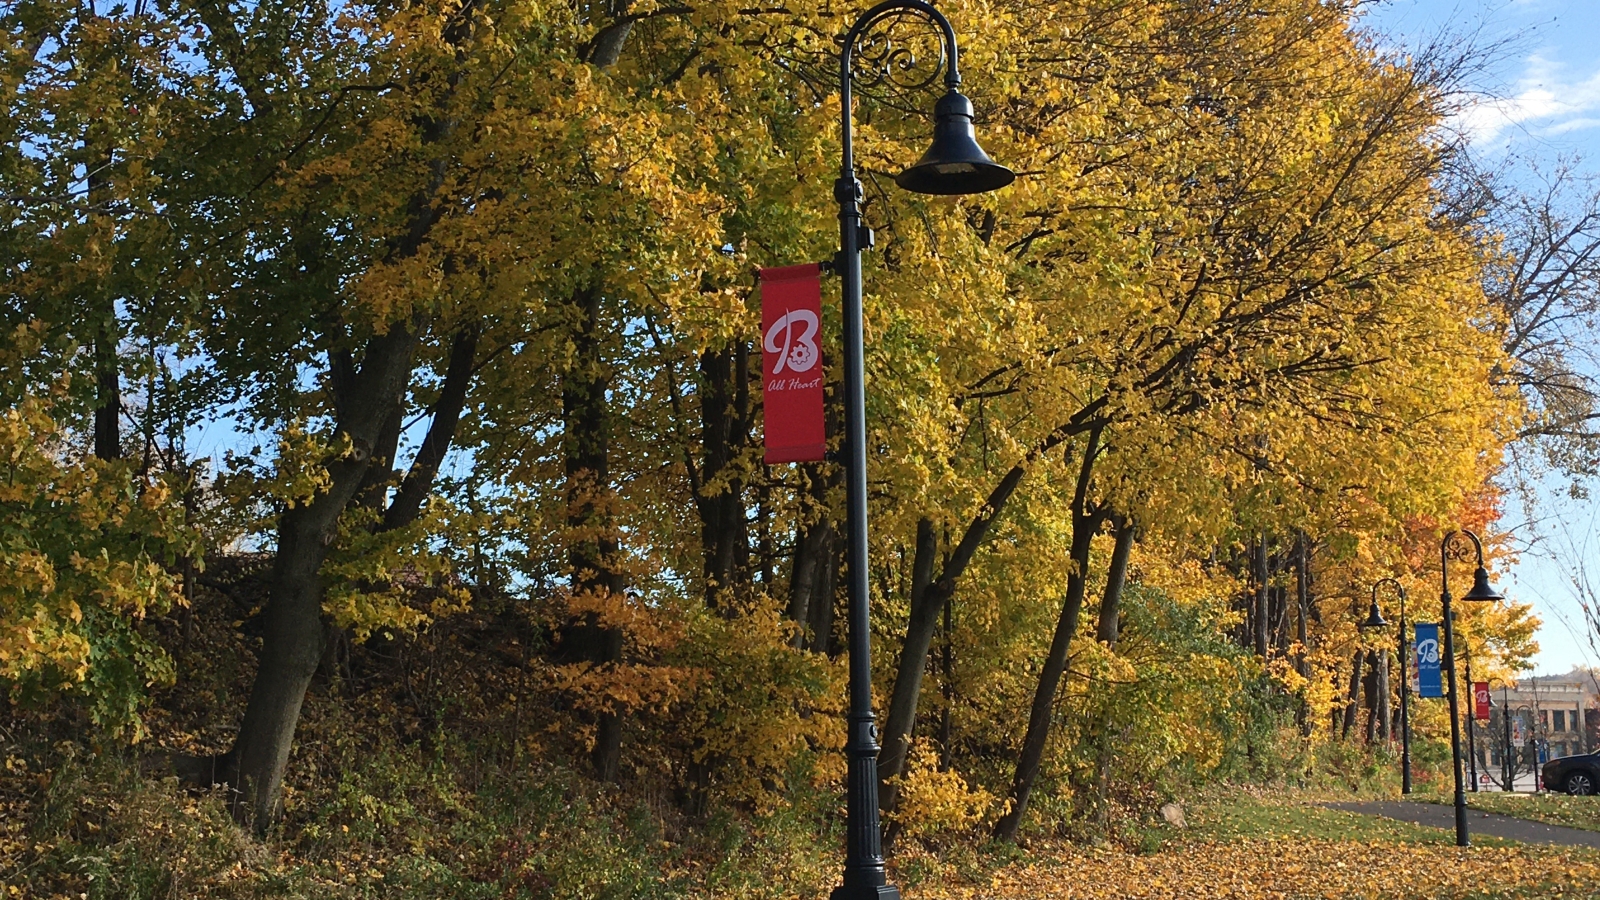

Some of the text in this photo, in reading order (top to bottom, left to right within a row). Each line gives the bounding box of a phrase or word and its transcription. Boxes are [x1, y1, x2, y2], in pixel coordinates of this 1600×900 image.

[764, 308, 819, 374] B
[768, 377, 821, 391] All Heart
[1417, 638, 1438, 663] B
[1476, 690, 1488, 703] B
